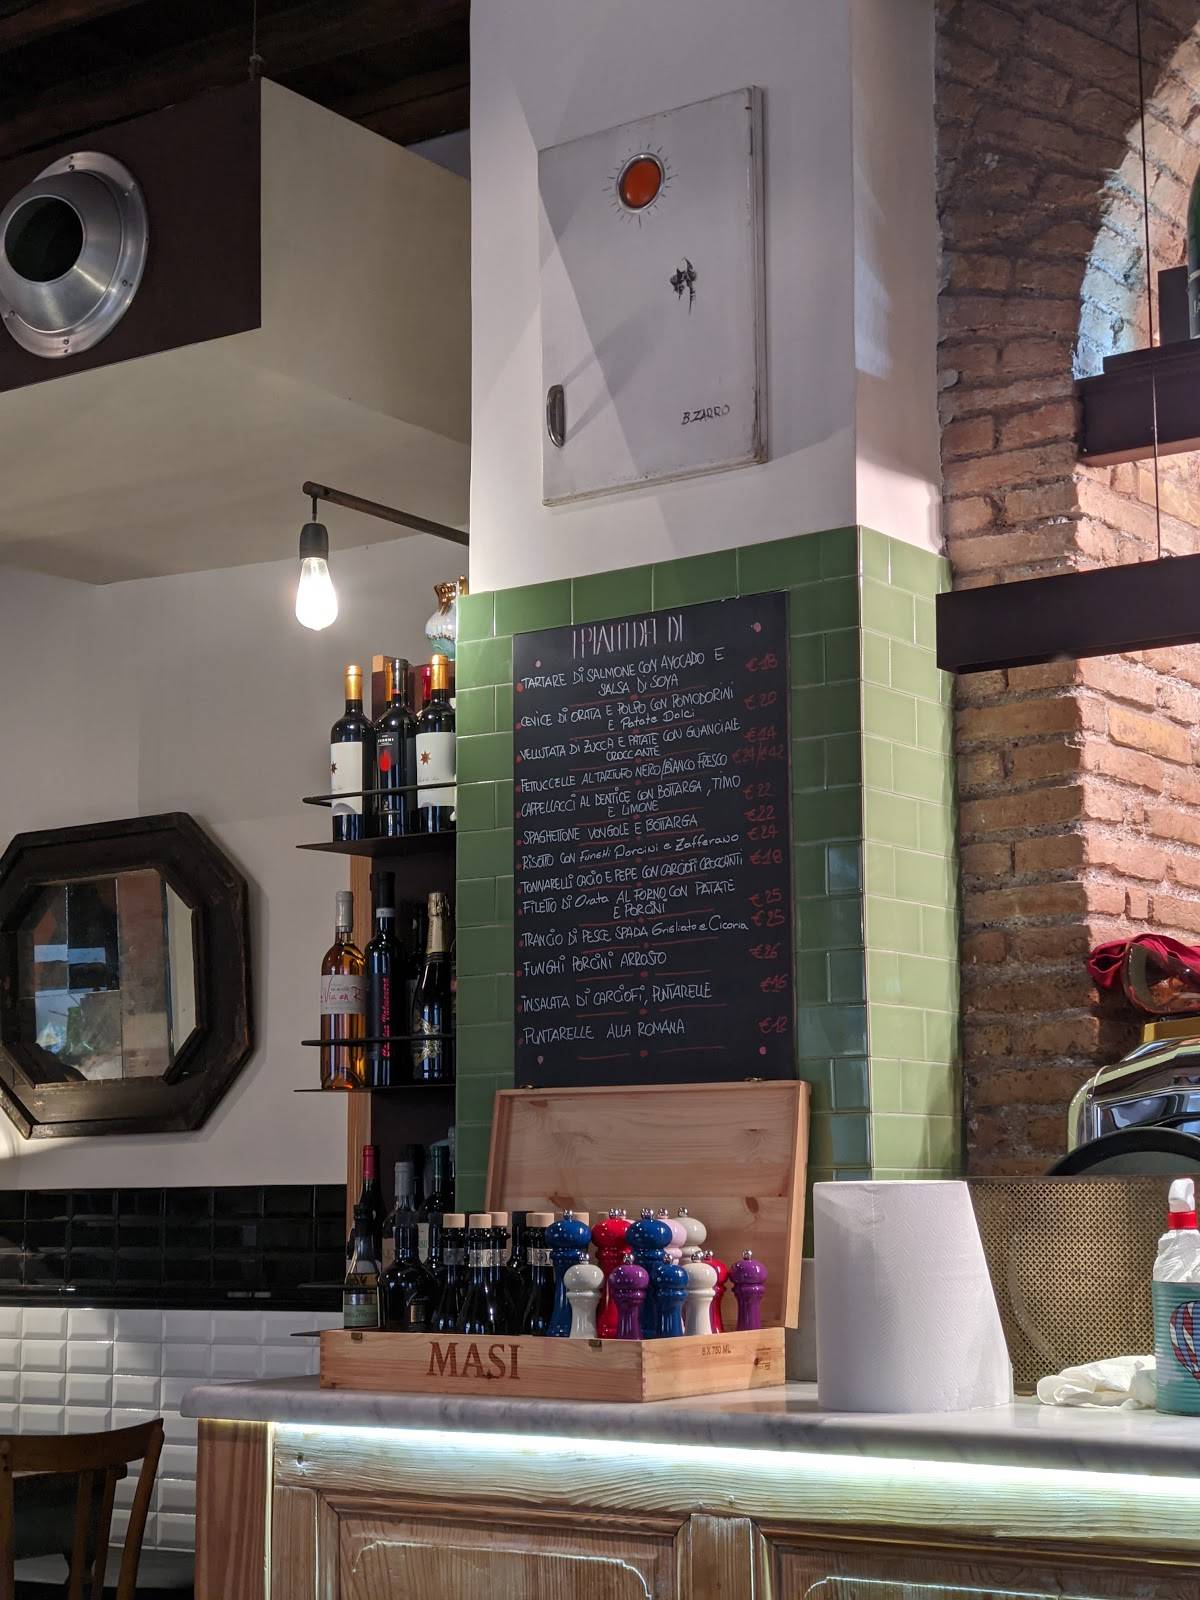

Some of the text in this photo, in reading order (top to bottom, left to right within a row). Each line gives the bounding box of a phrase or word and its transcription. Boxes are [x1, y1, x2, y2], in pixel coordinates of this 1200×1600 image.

[520, 674, 567, 689] TARTARE
[586, 664, 635, 682] SALMONE
[638, 659, 657, 673] CON
[661, 650, 705, 669] AVOCADO
[714, 647, 725, 661] E
[598, 682, 631, 696] SALSA
[650, 674, 679, 690] SOYA
[520, 711, 553, 727] CEVICE
[570, 707, 601, 722] ORATA
[606, 704, 613, 716] E
[617, 700, 646, 715] POLPO
[650, 698, 667, 712] CON
[672, 684, 734, 708] POMODORINI
[608, 708, 695, 731] E Patate Dolci
[520, 745, 566, 760] VELLUTATA
[583, 738, 614, 753] ZUCCA
[618, 736, 625, 747] E
[628, 732, 659, 746] PATATE
[662, 729, 682, 742] CON
[686, 719, 741, 738] GUANCIALE
[605, 746, 660, 761] CROCCANTE
[582, 773, 594, 785] AL
[595, 768, 633, 783] TARTUFO
[698, 752, 728, 769] FRESCO
[521, 794, 576, 817] CAPPELLACCI
[580, 795, 591, 808] AL
[595, 788, 631, 806] DENTICE
[637, 788, 654, 801] CON
[712, 775, 741, 790] TIMO
[608, 800, 659, 818] E LIMONE
[588, 823, 630, 840] VONGOLE
[635, 822, 642, 835] E
[645, 814, 698, 832] BOTTARGA
[520, 874, 573, 894] TONNARELLI
[577, 870, 603, 887] CACIO
[605, 871, 613, 883] E
[615, 867, 638, 882] PEPE
[641, 864, 659, 878] CON
[700, 849, 743, 871] CROCCANTI
[560, 852, 576, 864] CON
[574, 892, 610, 908] Orata
[616, 890, 631, 904] AL
[633, 887, 667, 902] FORNO
[668, 885, 688, 897] CON
[695, 879, 736, 896] PATATE
[613, 906, 621, 919] E
[522, 928, 564, 947] TRANCIO
[582, 928, 612, 943] PESCE
[615, 926, 649, 940] SPADA
[708, 914, 749, 931] Cicoria
[522, 950, 667, 977] FUNGHI PORCINI ARROSTO
[520, 995, 570, 1013] INSALATA
[652, 982, 712, 1003] PUNTARELLE
[523, 1018, 685, 1045] PUNTARELLE ALLA ROMANA
[426, 1341, 522, 1379] MASI
